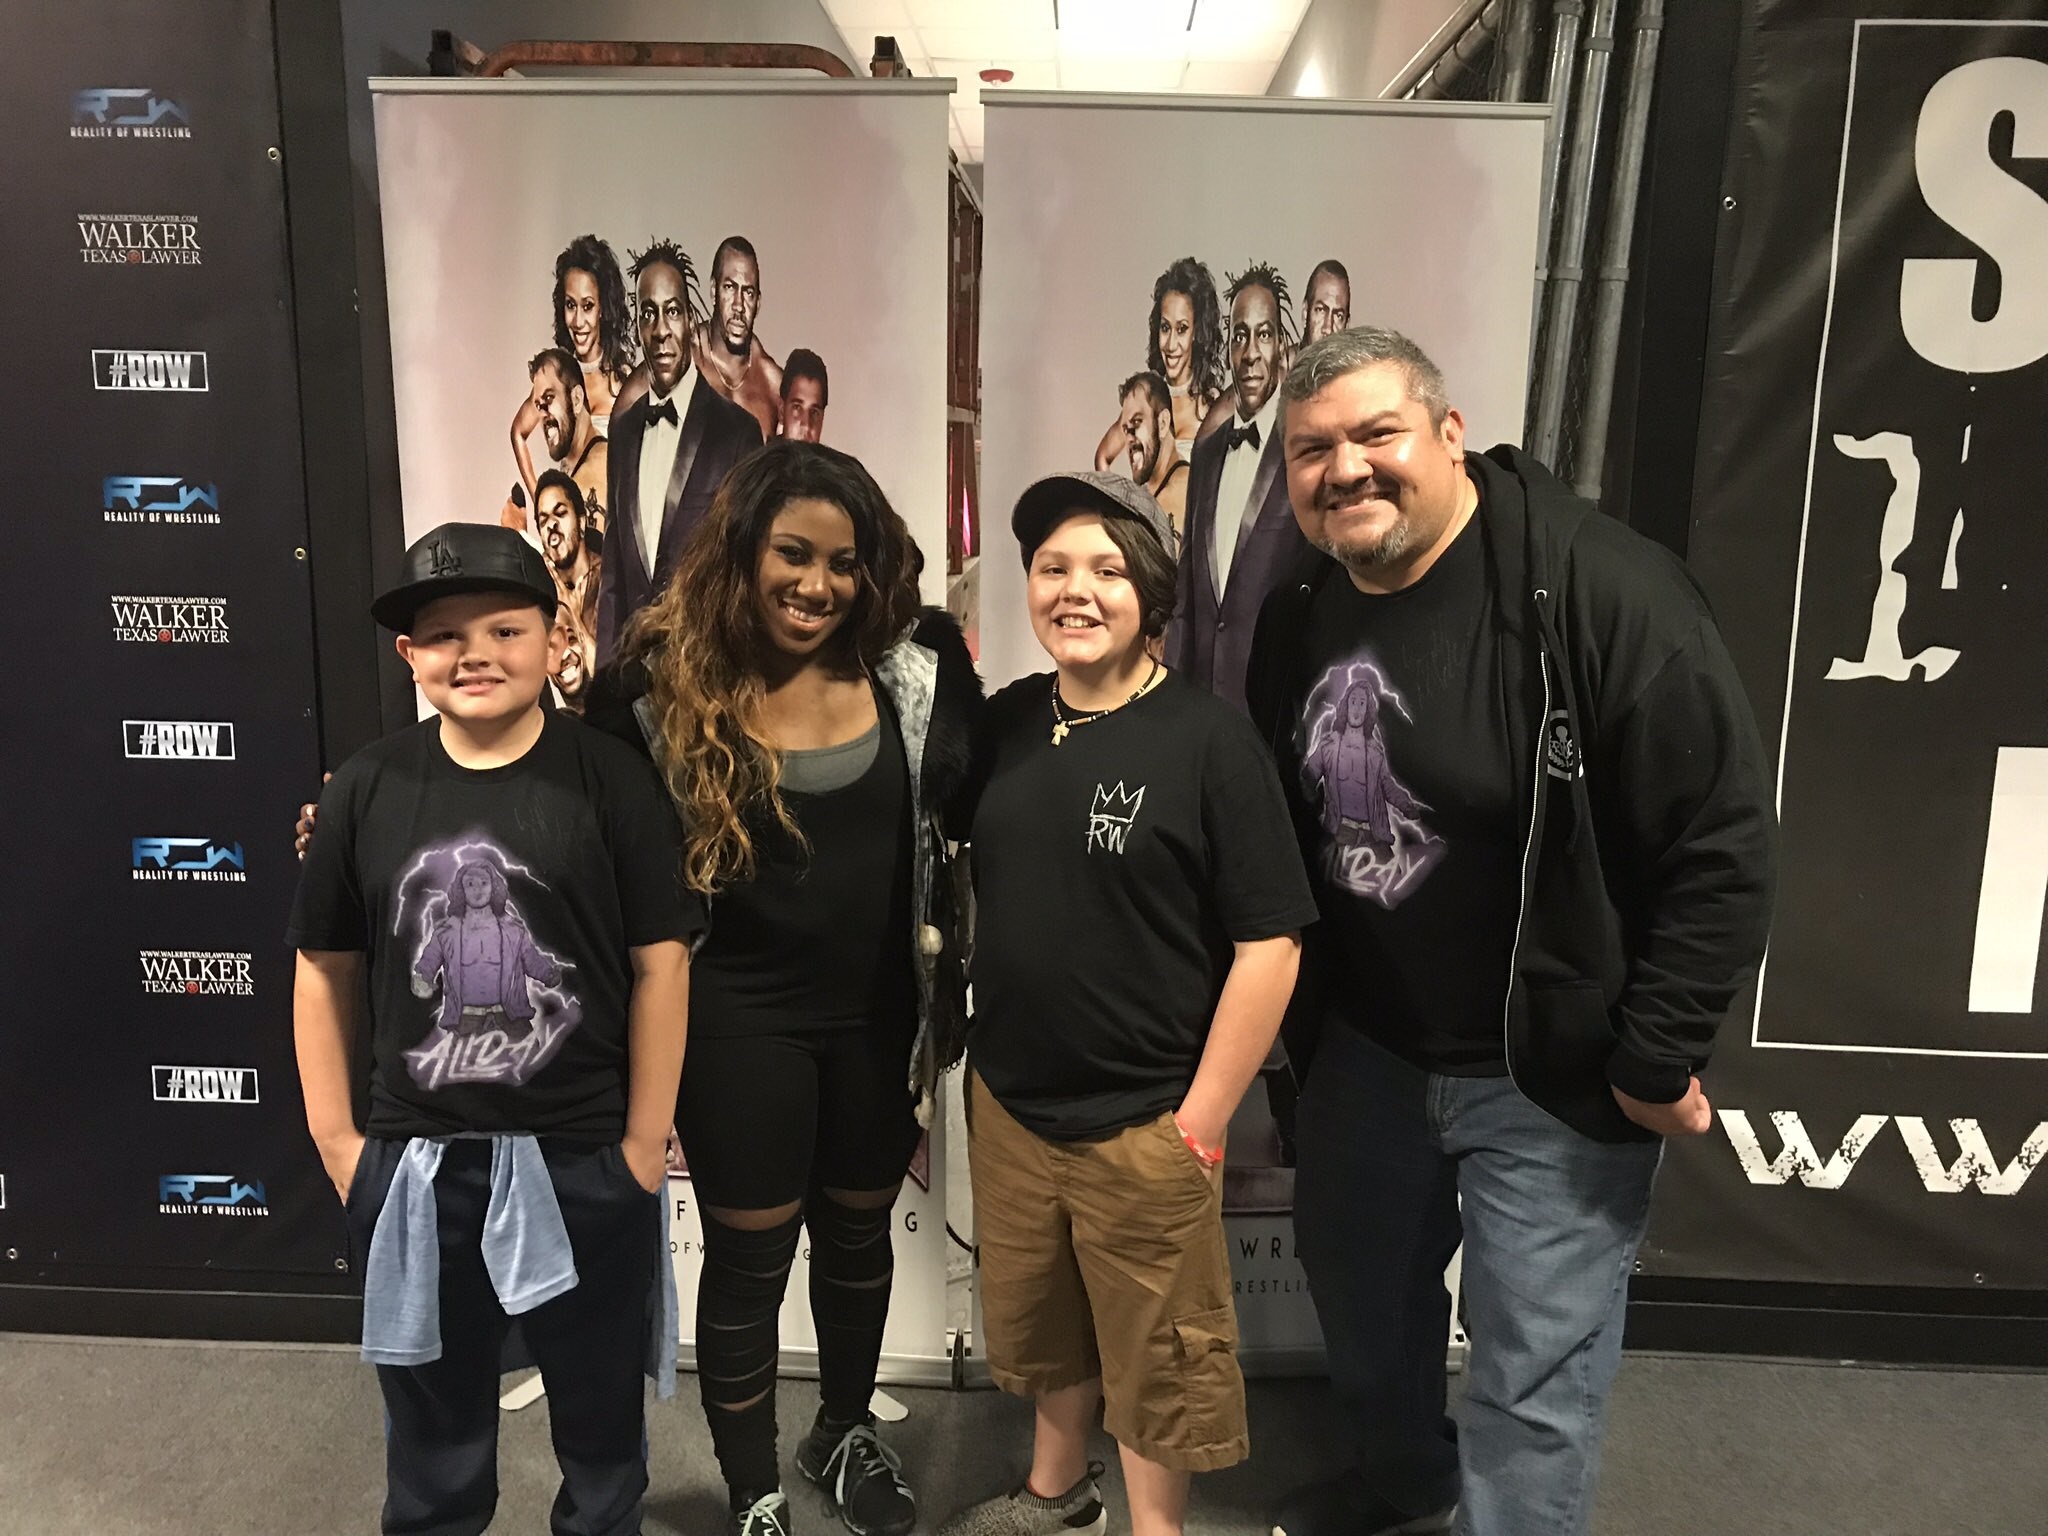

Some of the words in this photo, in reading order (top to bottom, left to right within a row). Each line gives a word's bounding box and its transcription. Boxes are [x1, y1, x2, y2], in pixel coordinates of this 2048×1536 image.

[70, 126, 112, 137] REALITY
[117, 127, 128, 138] OF
[133, 127, 192, 138] WRESTLING
[78, 213, 198, 223] WWW.WALKERTEXASLAWYER.COM
[77, 222, 201, 249] WALKER
[80, 249, 127, 263] TEXAS
[141, 250, 201, 265] LAWYER
[109, 352, 192, 388] #ROW
[104, 511, 144, 522] REALITY
[149, 511, 160, 523] OF
[165, 512, 221, 524] WRESTLING
[427, 539, 464, 577] LA
[111, 595, 227, 605] WWW.WALKERTEXASLAWYER.COM
[111, 603, 229, 629] WALKER
[113, 627, 158, 642] TEXAS
[172, 629, 230, 643] LAWYER
[139, 722, 219, 757] #ROW
[1085, 818, 1133, 854] RW
[132, 869, 172, 880] REALITY
[177, 870, 188, 881] OF
[192, 870, 246, 882] WRESTLING
[140, 950, 251, 960] WWW.WALKERTEXASLAWYER.COM
[140, 957, 254, 983] WALKER
[142, 980, 186, 994] TEXAS
[199, 981, 254, 996] LAWYER
[166, 1068, 243, 1101] #ROW
[159, 1204, 198, 1215] REALITY
[202, 1205, 213, 1215] OF
[217, 1205, 269, 1217] WRESTLING
